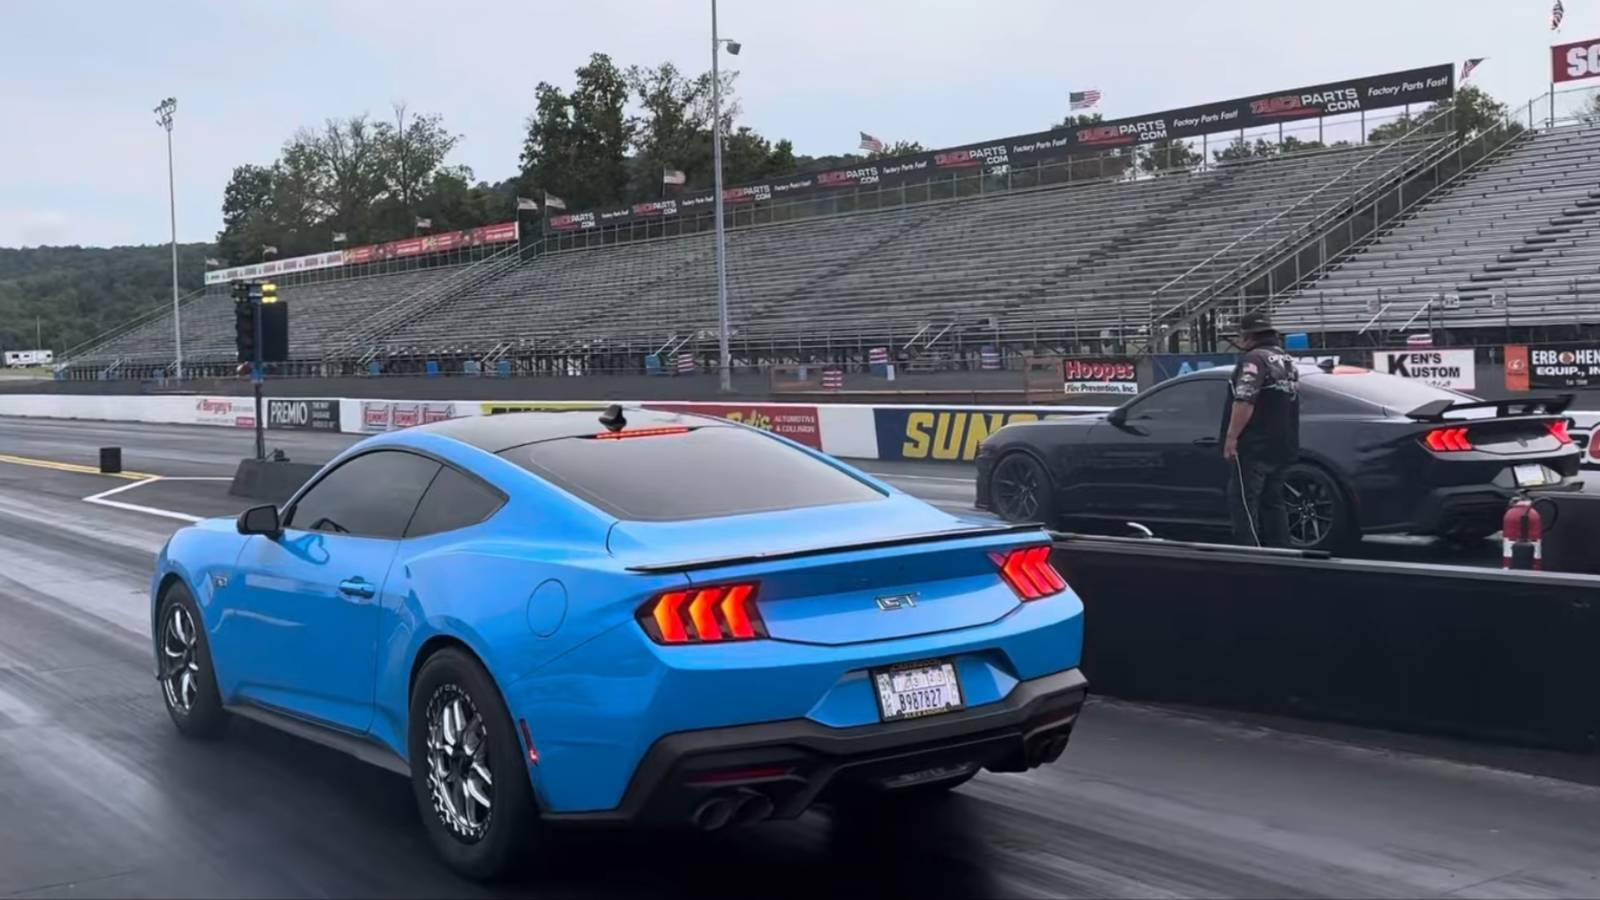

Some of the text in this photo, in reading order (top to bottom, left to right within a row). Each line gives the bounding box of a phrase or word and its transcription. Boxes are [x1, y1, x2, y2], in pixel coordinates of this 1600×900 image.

[1367, 84, 1400, 97] Factory
[1401, 81, 1424, 92] Parts
[1532, 351, 1557, 364] ERB
[1066, 360, 1135, 383] Hoopes
[270, 401, 308, 425] PREMIO
